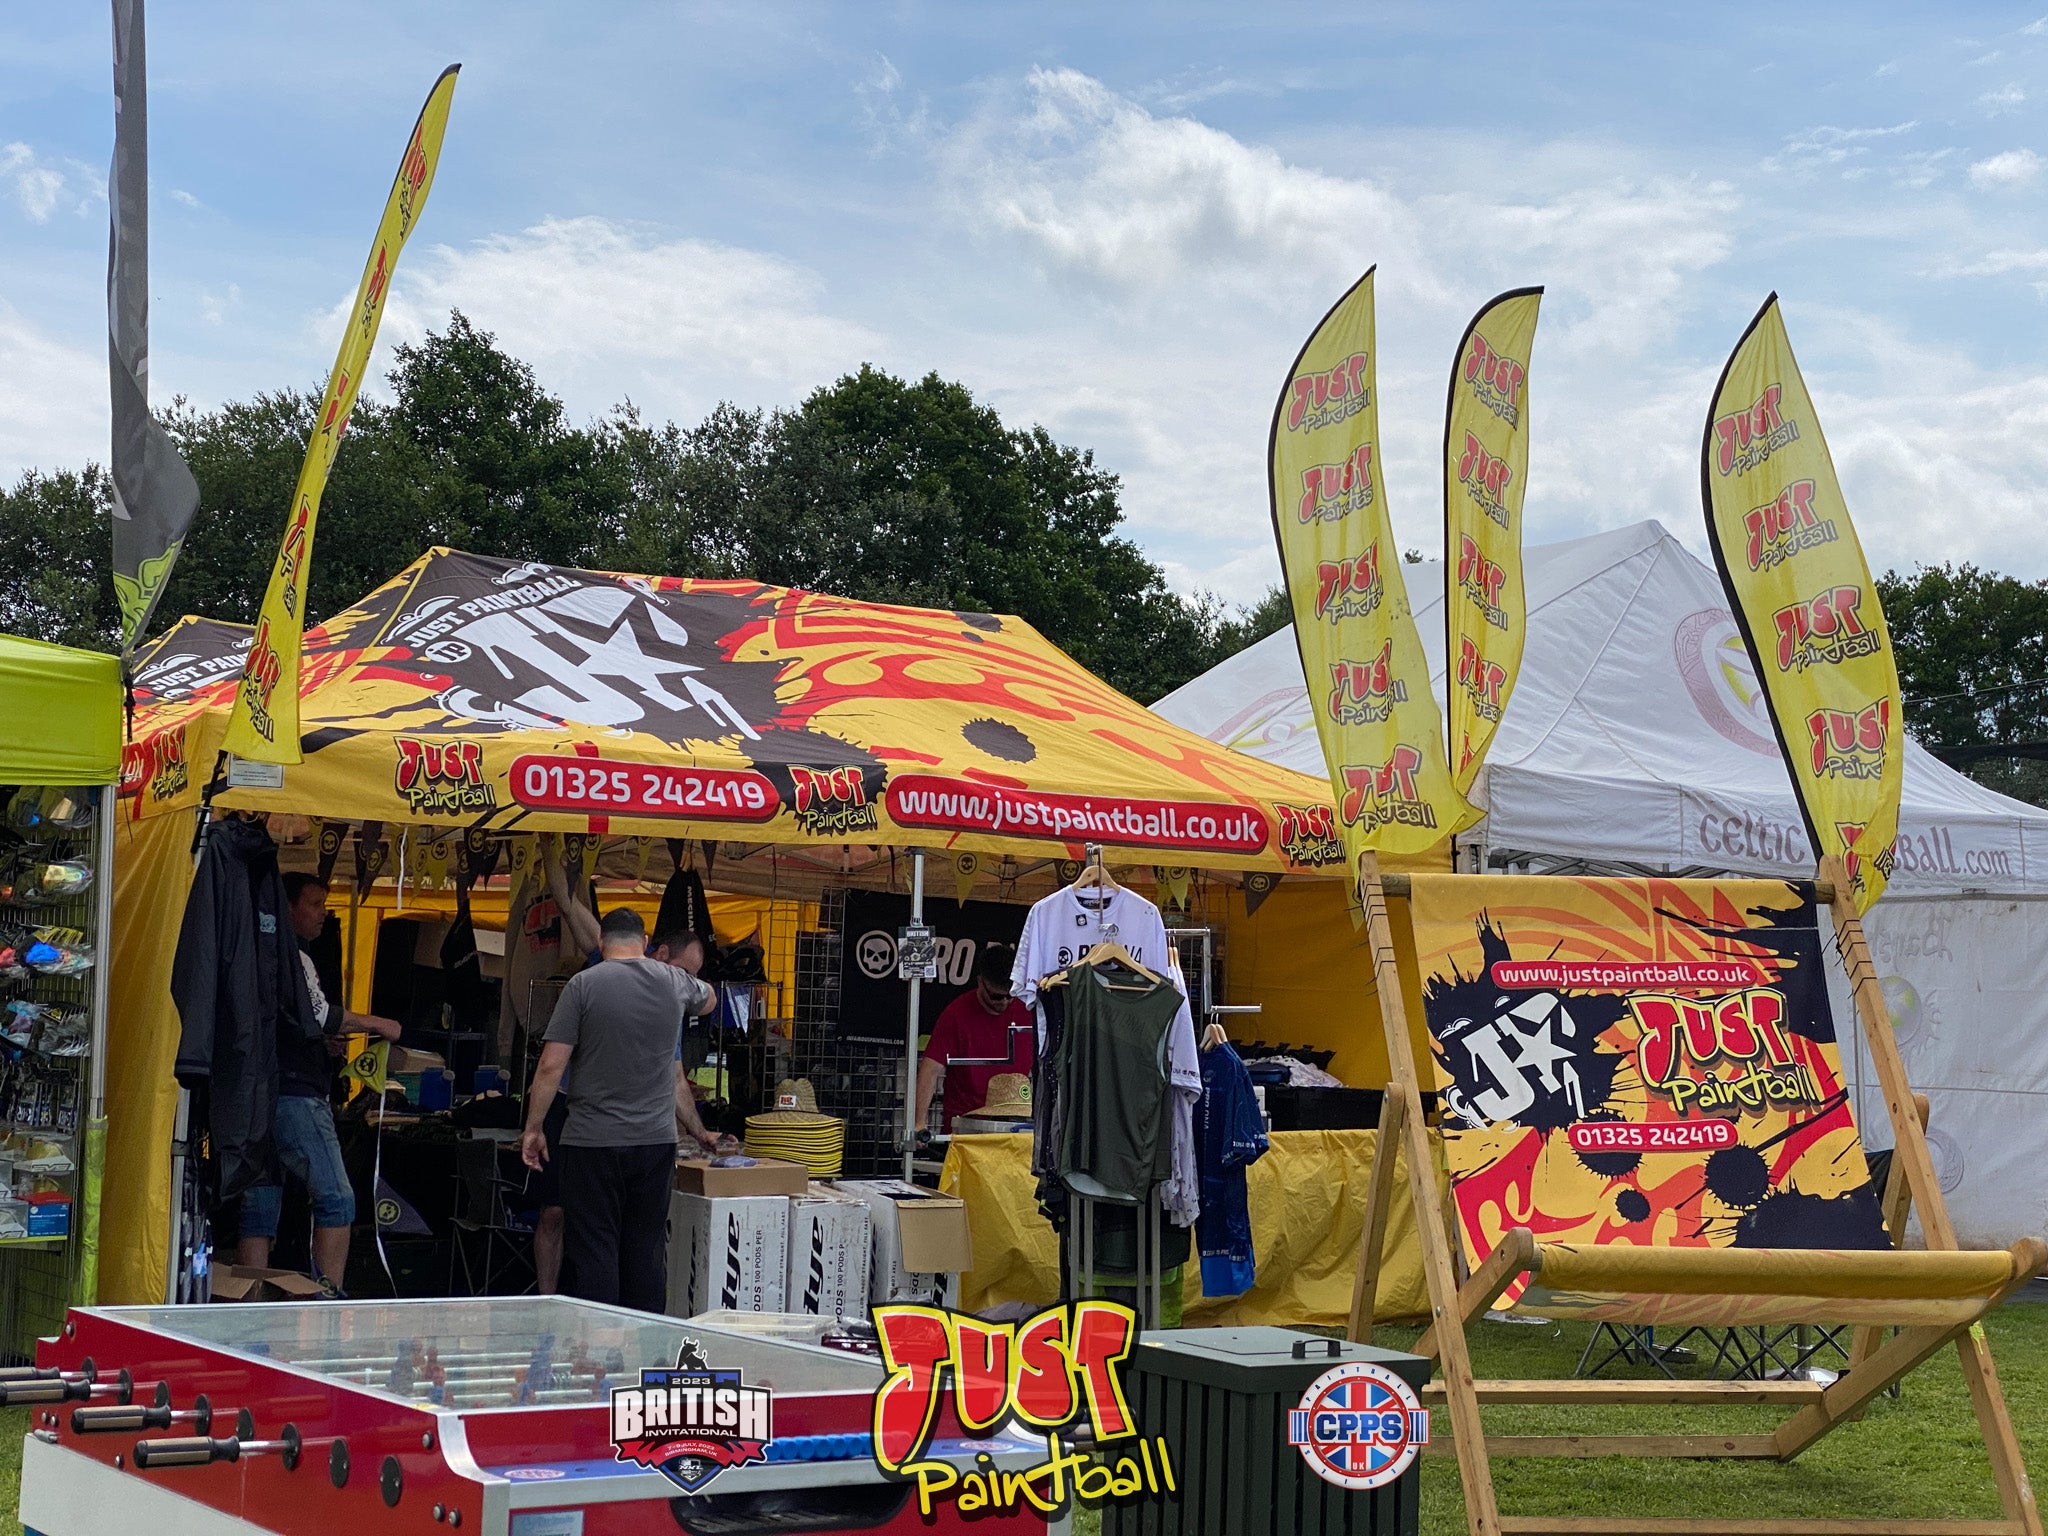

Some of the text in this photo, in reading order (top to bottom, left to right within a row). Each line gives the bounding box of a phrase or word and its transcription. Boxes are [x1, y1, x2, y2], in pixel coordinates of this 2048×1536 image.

[1287, 352, 1367, 432] JUST
[1464, 330, 1525, 406] JUST
[1713, 383, 1785, 477] JUST
[1733, 420, 1800, 477] Paintball
[1298, 443, 1372, 524] JUST
[1459, 429, 1513, 506] JUST
[1743, 478, 1820, 572] JUST
[1760, 519, 1838, 572] Paintball
[404, 574, 582, 648] JUST PAINTBALL
[1772, 585, 1866, 672] JUST
[1792, 629, 1881, 674] Paintball
[149, 668, 203, 691] JUST
[395, 737, 486, 795] JUST
[523, 763, 766, 810] 01325 242419
[787, 765, 866, 812] JUST
[409, 778, 496, 812] Paintball
[803, 800, 877, 834] Paintball
[897, 785, 1260, 845] www.justpaintball.co.uk
[1280, 800, 1335, 848] JUST
[1289, 834, 1346, 868] Paintball
[1499, 964, 1751, 988] www.justpaintball.co.uk
[1627, 990, 1798, 1088] JUST
[1661, 1064, 1821, 1113] Paintball
[1576, 1123, 1730, 1147] 01325 242419
[755, 1229, 763, 1247] PER
[837, 1250, 845, 1272] PODS
[753, 1285, 762, 1312] ODS
[836, 1273, 844, 1286] 100
